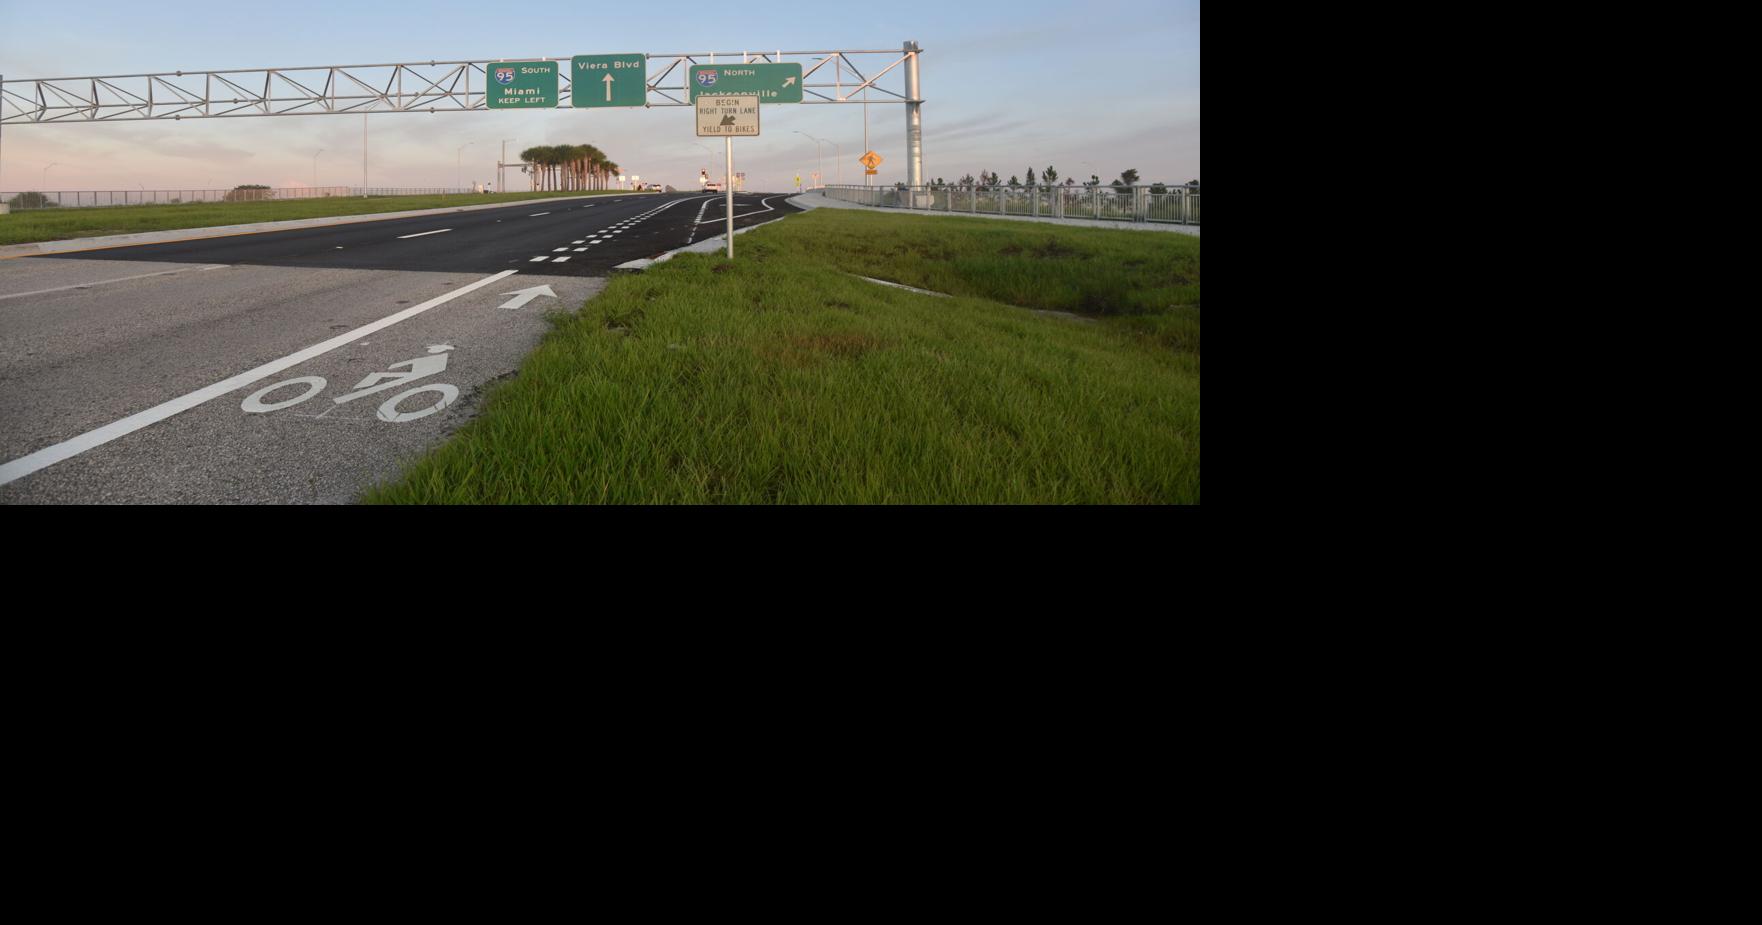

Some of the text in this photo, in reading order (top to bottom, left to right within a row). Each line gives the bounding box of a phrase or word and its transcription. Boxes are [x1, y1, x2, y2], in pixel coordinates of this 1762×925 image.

[578, 60, 640, 70] Viera Blvd
[496, 72, 513, 82] 95
[698, 69, 756, 84] 95 NORTH
[504, 87, 540, 96] Miami
[699, 107, 717, 115] RIGHT
[721, 107, 737, 115] TURN
